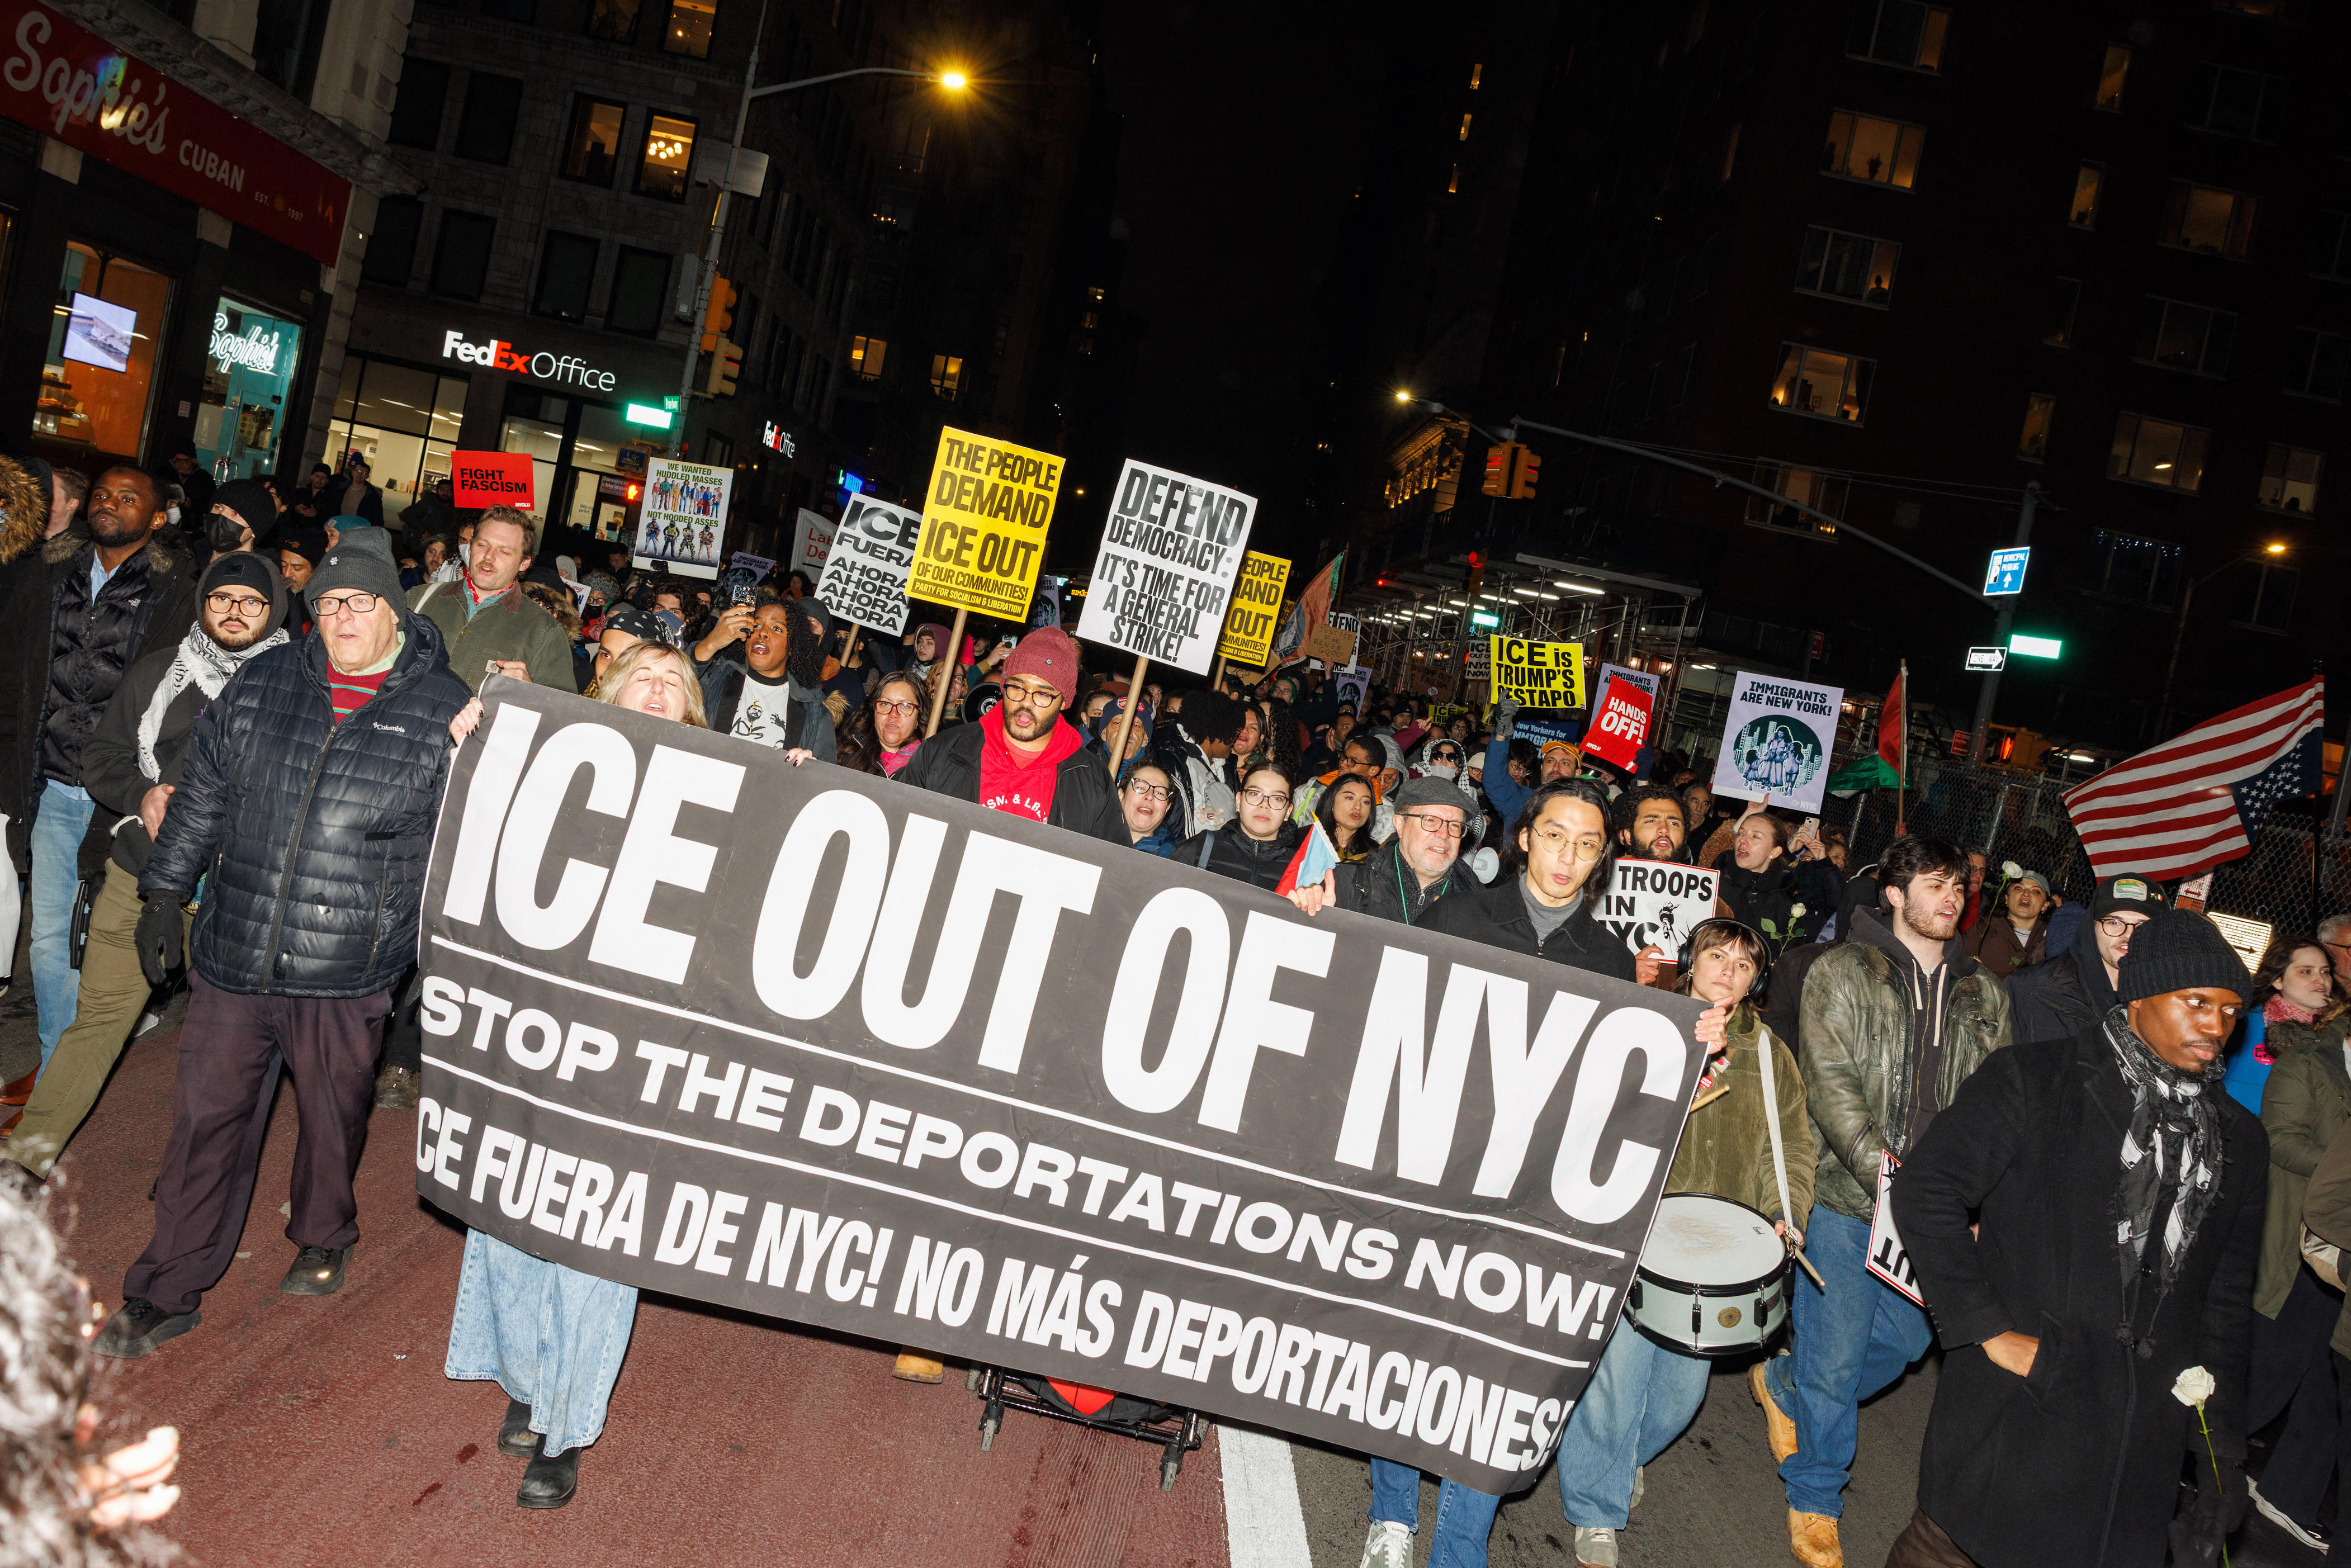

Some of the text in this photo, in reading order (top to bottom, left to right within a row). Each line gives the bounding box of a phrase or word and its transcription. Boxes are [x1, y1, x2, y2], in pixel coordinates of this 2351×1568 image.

[3, 11, 245, 192] Sophie's CUBAN
[255, 191, 304, 221] EST. 1997
[443, 330, 615, 391] FedEx Office
[763, 420, 795, 458] FedEx Office
[460, 468, 504, 481] FIGHT
[656, 470, 723, 486] HUDDLED MASSES
[682, 465, 712, 476] WANTED
[947, 438, 1057, 492] THE PEOPLE
[461, 480, 527, 493] FASCISM
[934, 470, 1050, 528] DEMAND
[664, 513, 693, 524] HOODED
[695, 518, 718, 527] ASSES
[1118, 467, 1247, 547] DEFEND
[844, 500, 921, 551] ICE
[807, 544, 830, 560] De
[923, 518, 1039, 581] ICE OUT
[1107, 514, 1233, 578] DEMOCRACY:
[2003, 553, 2025, 562] MUNICIPAL
[738, 556, 769, 566] IMMIGRANTS
[1242, 557, 1286, 582] EOPLE
[2001, 562, 2019, 571] PARKING
[825, 570, 907, 605] AHORA
[916, 561, 1029, 601] OF OUR COMMUNITIES!
[1098, 553, 1225, 615] IT'S TIME FOR
[821, 582, 902, 618] AHORA
[915, 581, 1022, 614] PARTY FOR SOCIALISM & LIBERATION
[821, 595, 898, 631] AHORA
[1102, 585, 1200, 639] A GENERAL
[1229, 607, 1273, 639] OUT
[1109, 615, 1184, 663] STRIKE!
[1314, 638, 1342, 650] RENEE
[1318, 626, 1353, 641] JUSTICE
[1324, 636, 1340, 644] FOR
[1237, 651, 1262, 661] LIBERATION
[1318, 647, 1343, 657] GOOD
[1470, 642, 1491, 653] ICE
[1498, 637, 1572, 667] ICE is
[1496, 662, 1575, 689] TRUMP'S
[1609, 670, 1651, 685] IMMIGRANTS
[1740, 691, 1832, 716] ARE NEW YORK!
[1749, 681, 1828, 704] IMMIGRANTS
[1434, 706, 1455, 716] ICE
[1608, 697, 1647, 724] HANDS
[377, 724, 405, 733] Columbia
[1515, 722, 1567, 738] New Yorkers for
[1601, 711, 1645, 745] OFF!
[1586, 742, 1601, 751] NYCLU
[1013, 794, 1020, 804] &
[1800, 801, 1817, 811] NYIC
[1619, 865, 1713, 902] TROOPS
[1605, 895, 1635, 917] IN
[1598, 920, 1660, 951] YC
[443, 702, 1686, 1224] ICE OUT OF NYC
[422, 976, 1616, 1340] STOP THE DEPORTATIONS NOW!
[470, 1125, 648, 1257] FUERA
[655, 1182, 748, 1276] DE
[746, 1202, 893, 1307] NYC!
[894, 1235, 983, 1327] NO
[986, 1255, 1122, 1358] MÁS
[1124, 1290, 1575, 1472] DEPORTACIONES!
